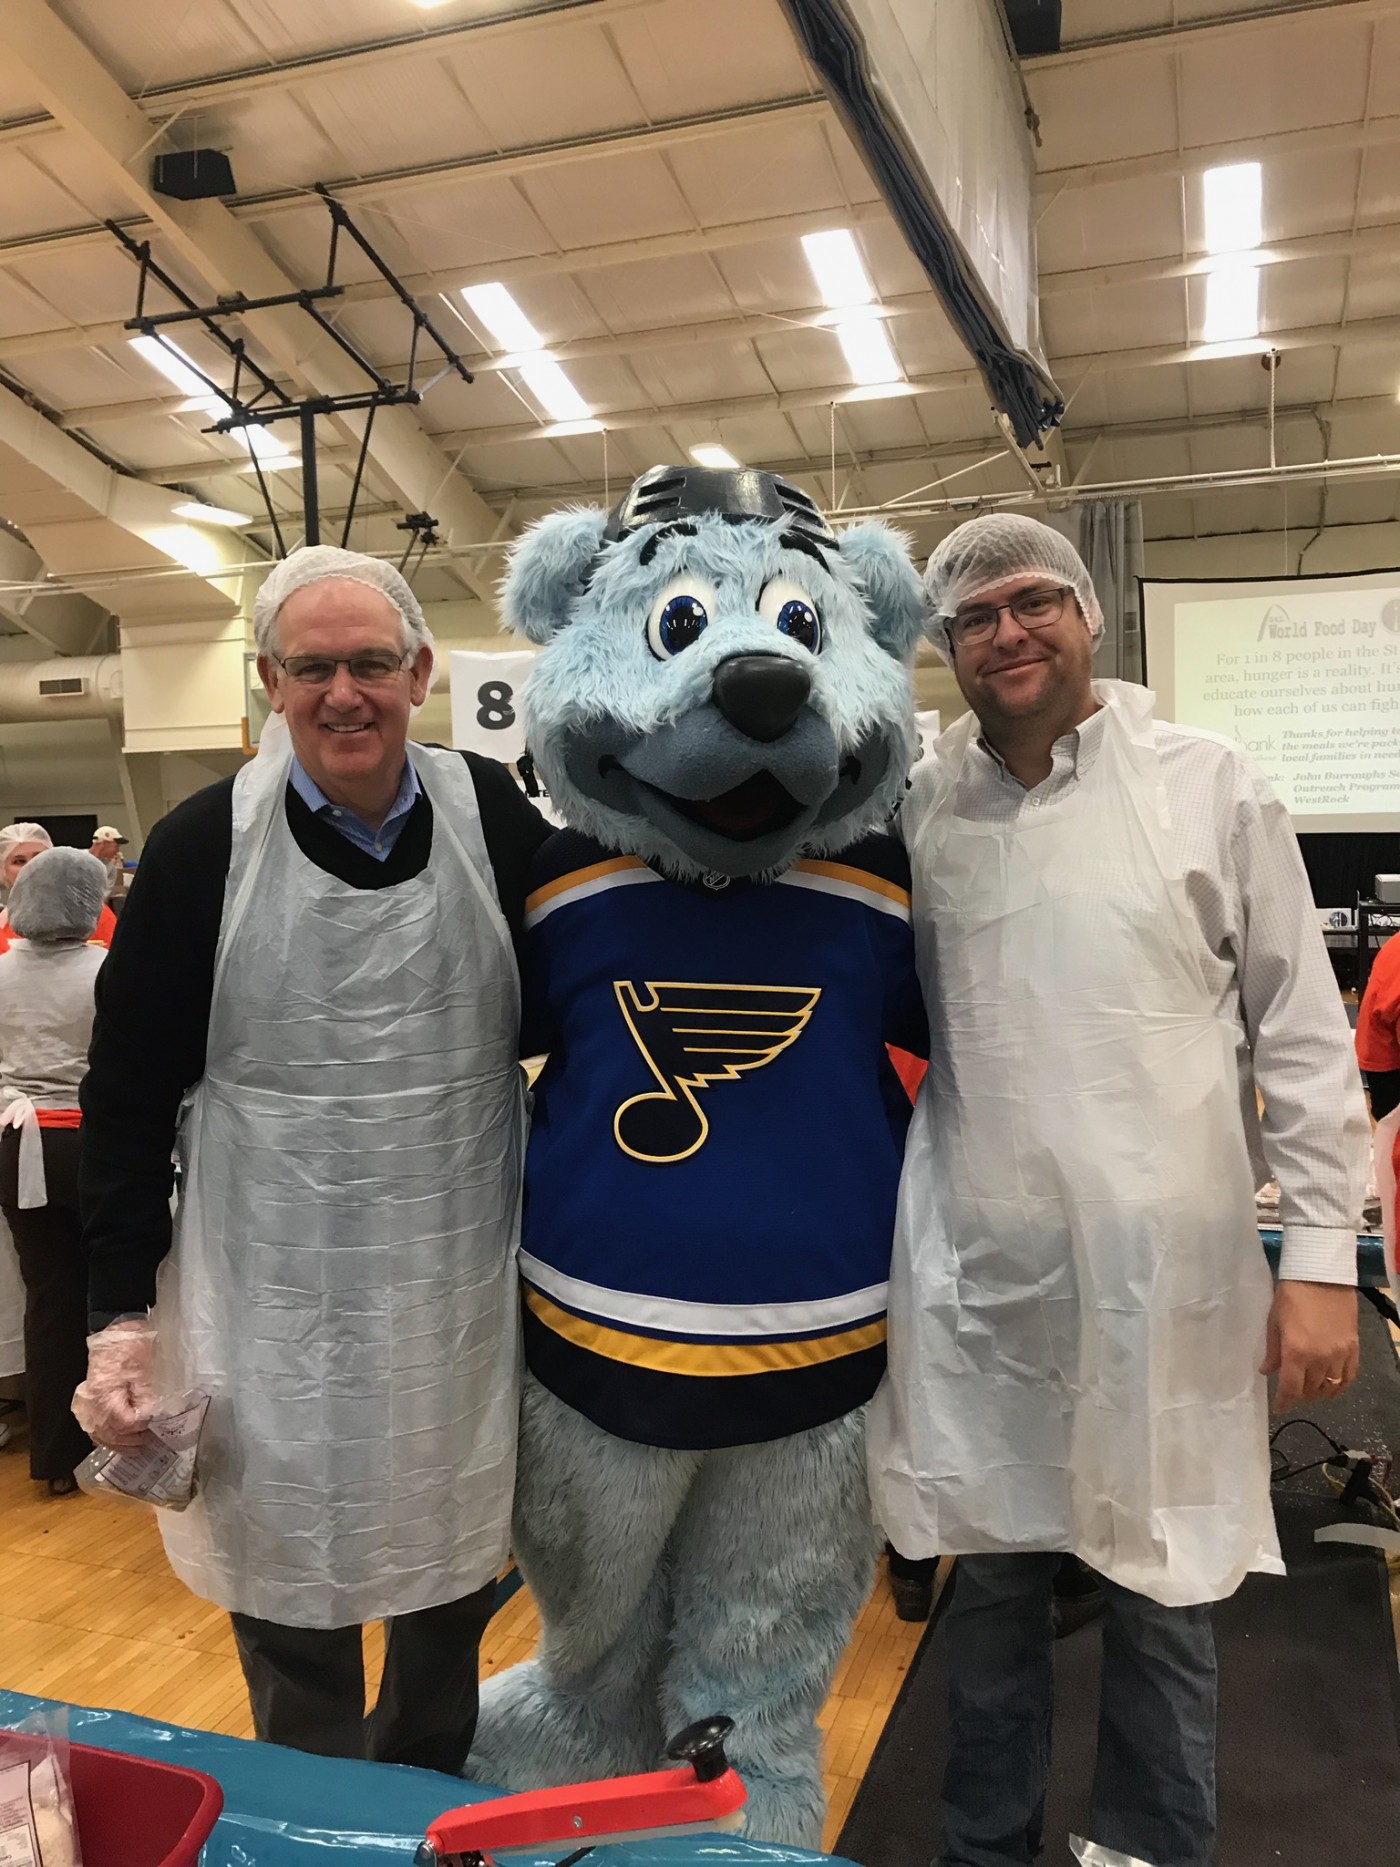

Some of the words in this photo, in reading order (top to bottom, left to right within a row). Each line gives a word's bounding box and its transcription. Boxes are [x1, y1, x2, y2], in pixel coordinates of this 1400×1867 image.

[1269, 621, 1307, 639] World
[1314, 619, 1346, 637] Food
[1353, 619, 1377, 639] Day
[1216, 653, 1240, 666] For
[1245, 655, 1250, 664] 1
[1255, 652, 1269, 664] in
[1272, 651, 1282, 663] 8
[1286, 647, 1334, 665] people
[1338, 646, 1352, 659] in
[1356, 645, 1380, 658] the
[1205, 672, 1239, 684] area,
[1244, 669, 1294, 683] hunger
[1297, 667, 1309, 679] is
[1312, 669, 1321, 678] a
[1325, 664, 1376, 679] reality.
[1203, 688, 1257, 702] educate
[1261, 684, 1327, 698] ourselves
[1331, 682, 1372, 696] about
[477, 680, 516, 730] 8
[1234, 704, 1263, 718] how
[1267, 702, 1299, 716] each
[1303, 701, 1319, 714] of
[1321, 703, 1338, 713] us
[1341, 702, 1367, 713] can
[1281, 729, 1324, 740] Thanks
[1324, 728, 1345, 740] for
[1346, 727, 1389, 738] helping
[1282, 742, 1300, 751] the
[1302, 741, 1335, 751] meals
[1282, 753, 1309, 763] local
[1309, 752, 1358, 764] families
[1360, 751, 1371, 760] in
[1293, 772, 1321, 782] John
[1324, 770, 1386, 781] Burroughs
[1293, 783, 1346, 793] Outreach
[1294, 795, 1350, 804] WestRock
